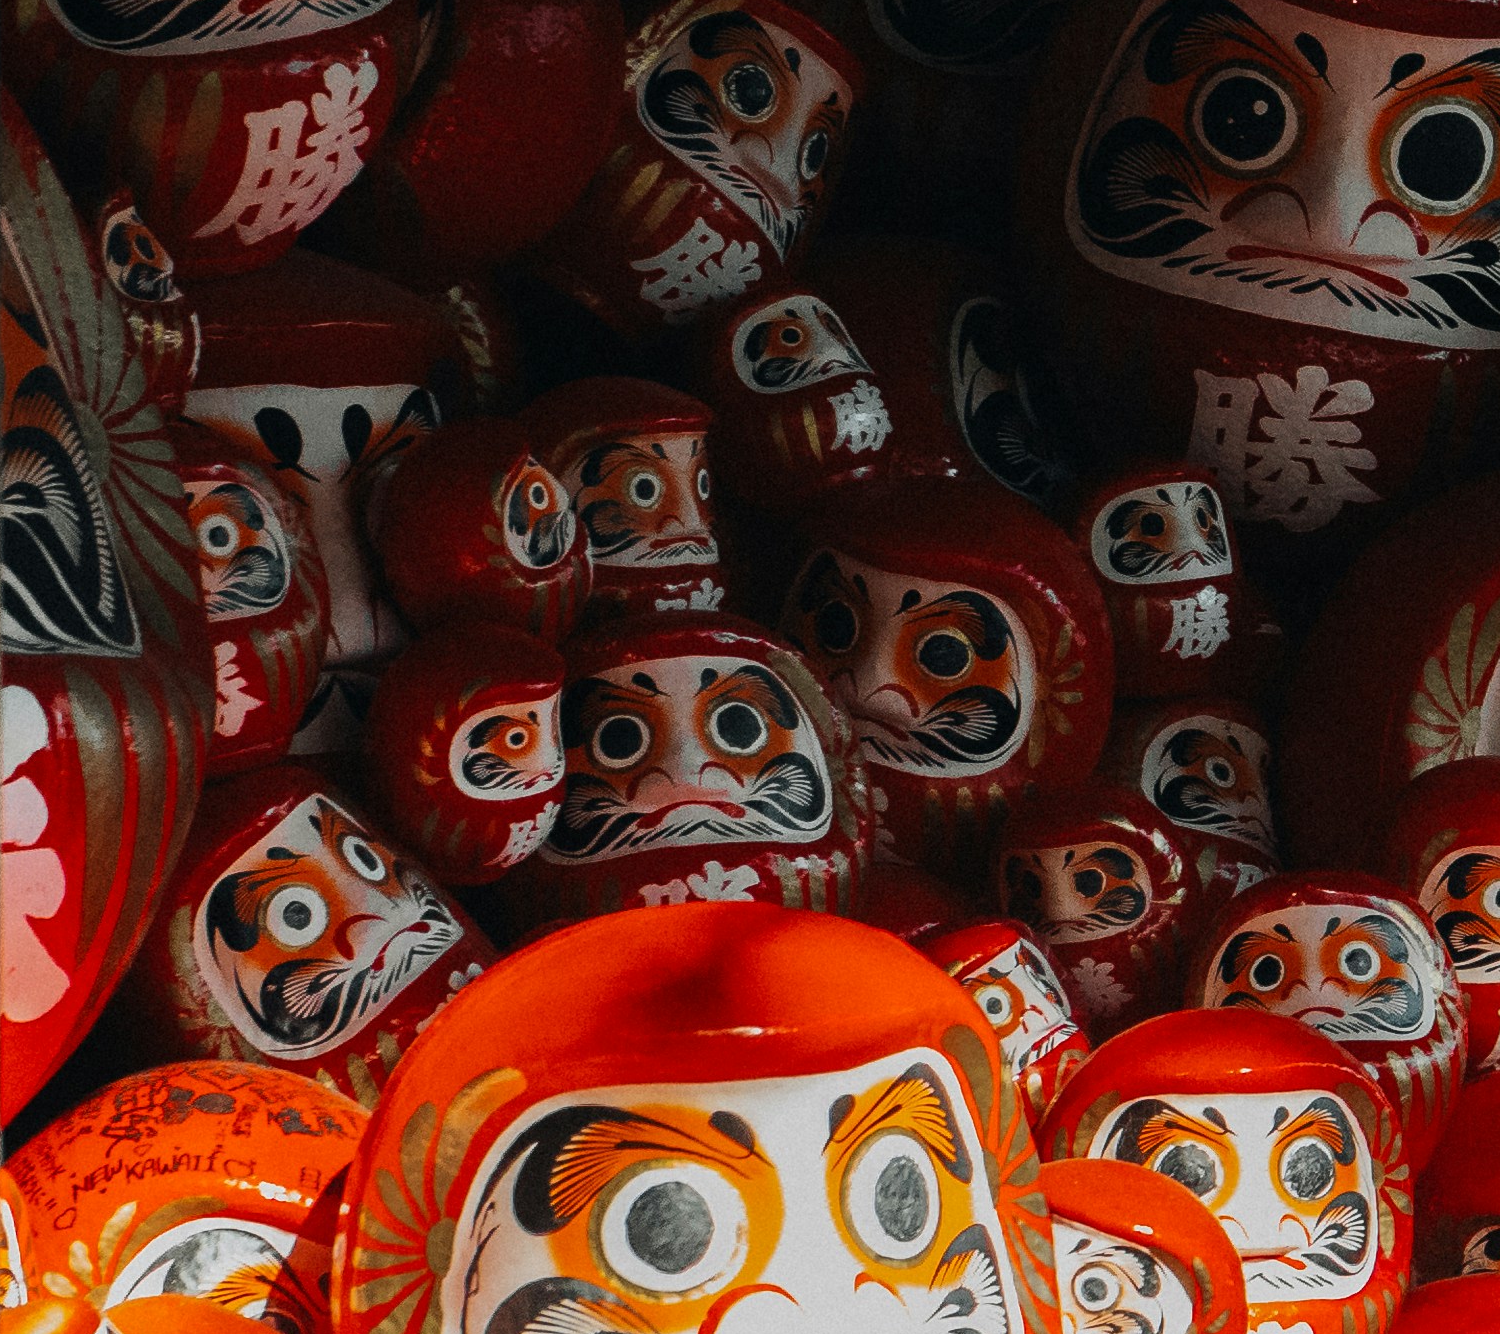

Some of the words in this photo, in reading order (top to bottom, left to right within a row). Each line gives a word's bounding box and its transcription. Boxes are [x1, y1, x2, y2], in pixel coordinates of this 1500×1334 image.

[193, 59, 379, 247] 勝
[630, 217, 762, 313] 勝
[826, 379, 892, 453] 勝
[1186, 365, 1383, 533] 勝
[1160, 583, 1230, 659] 勝
[488, 800, 560, 866] 勝
[72, 1159, 123, 1202] NEW
